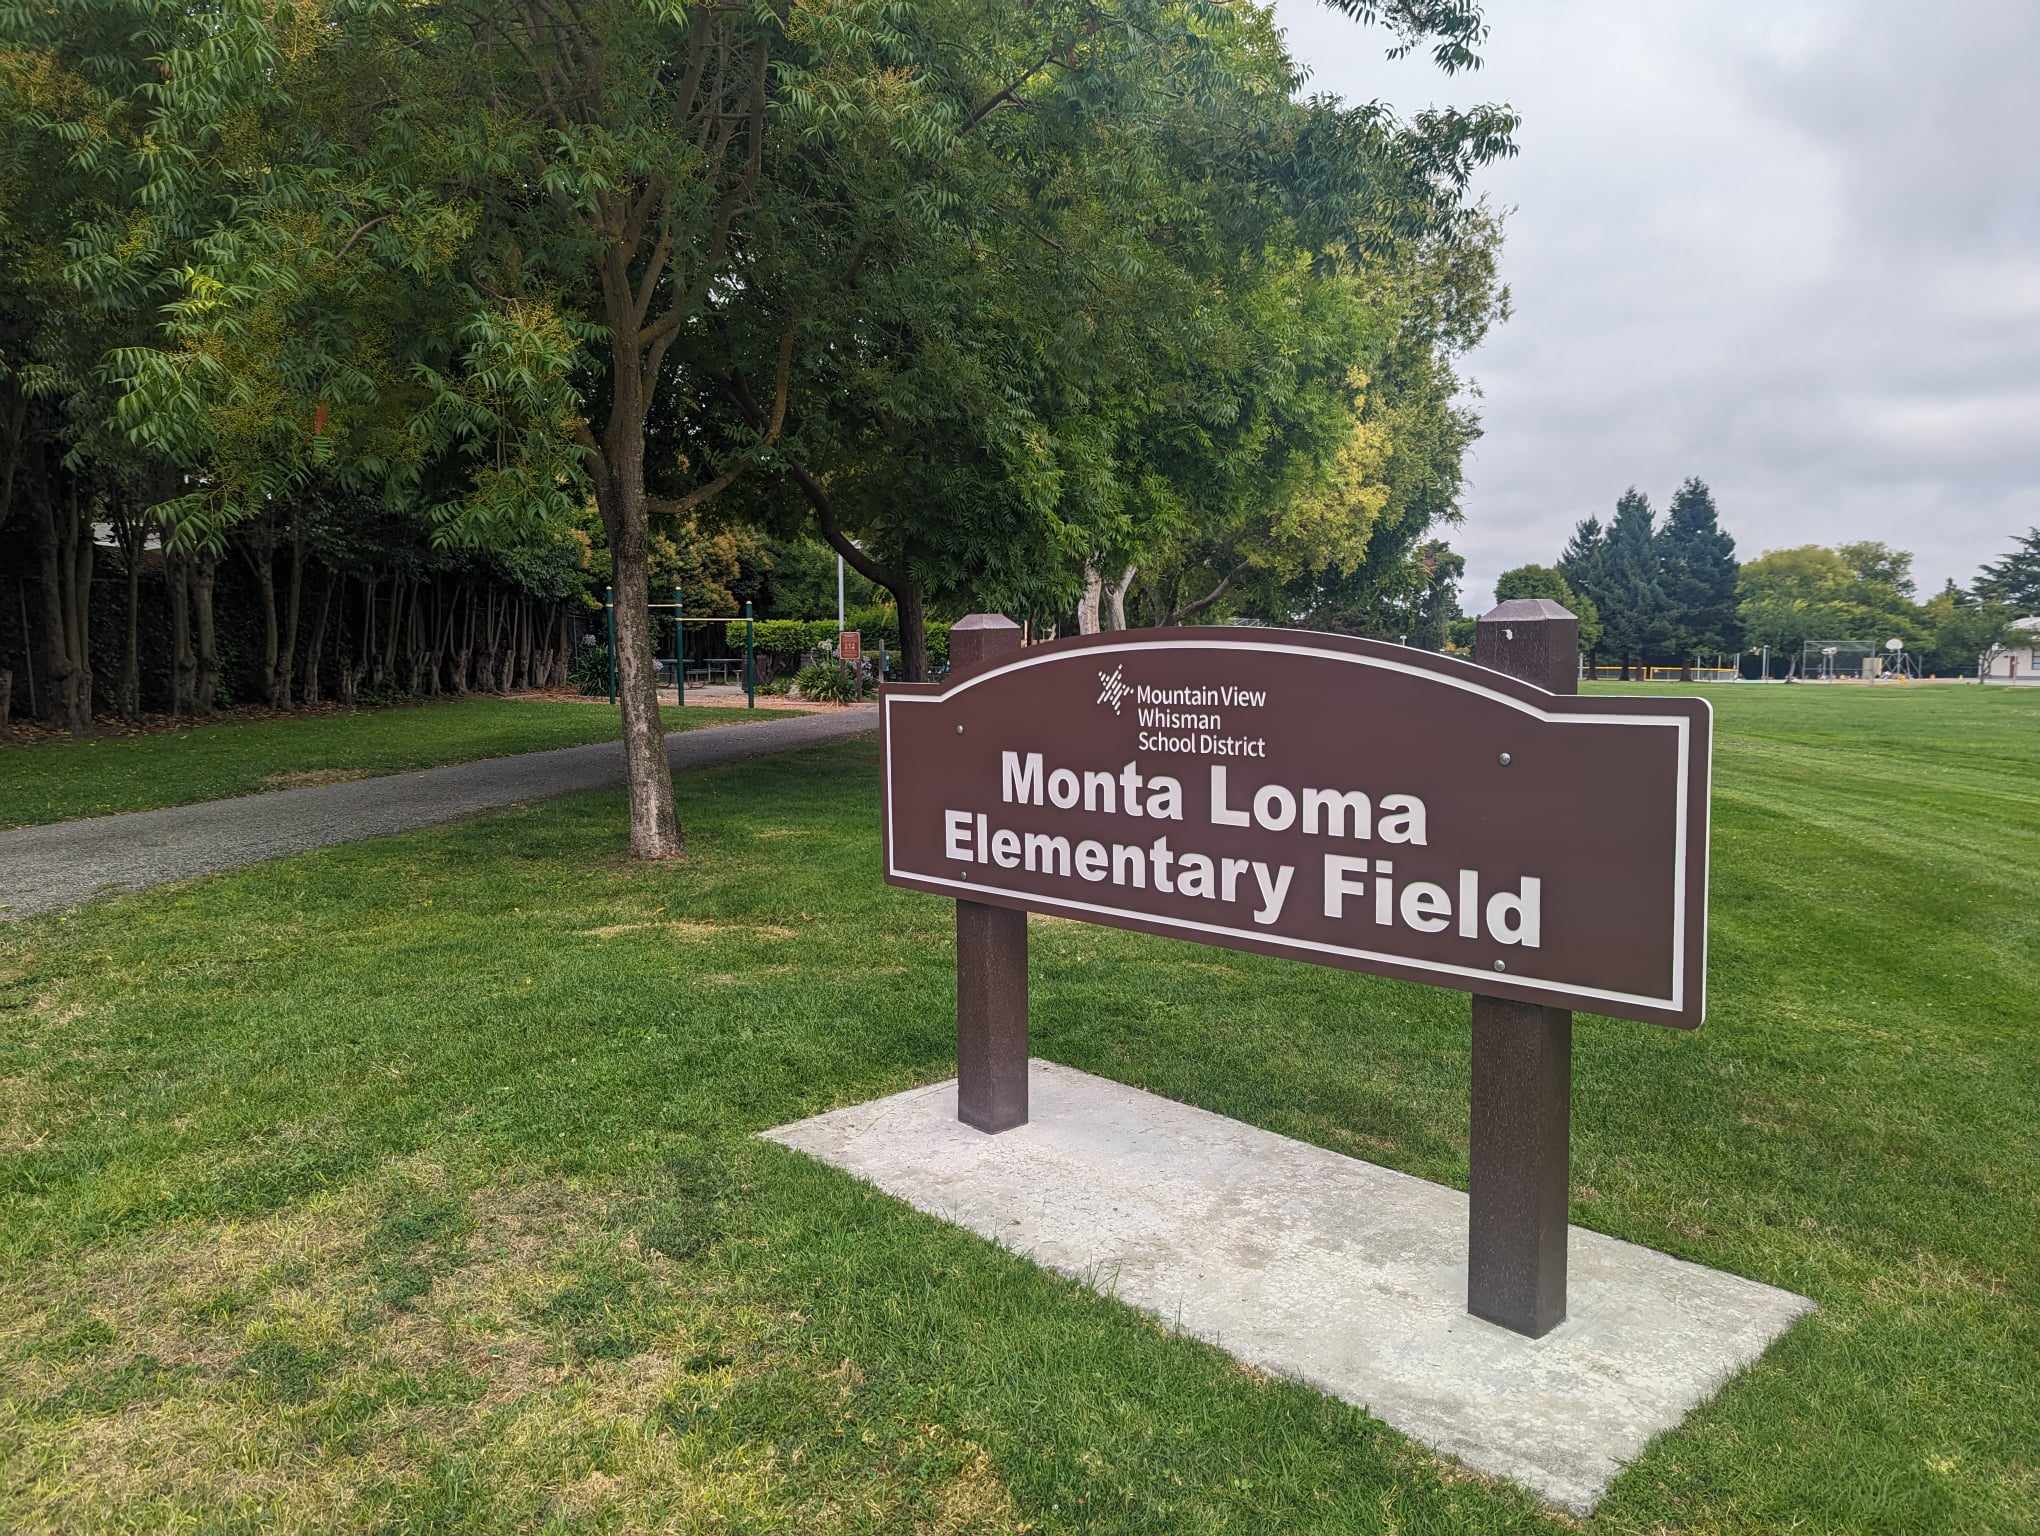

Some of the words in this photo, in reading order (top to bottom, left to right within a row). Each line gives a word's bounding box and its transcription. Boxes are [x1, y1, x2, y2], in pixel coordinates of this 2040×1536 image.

[1137, 685, 1219, 706] Mountain
[1220, 686, 1267, 707] View
[1137, 707, 1221, 730] Whisman
[1138, 731, 1197, 754] School
[1200, 734, 1266, 758] District
[1002, 750, 1184, 822] Monta
[1210, 764, 1428, 847] Loma
[944, 809, 1295, 925] Elementary
[1324, 853, 1542, 949] Field
